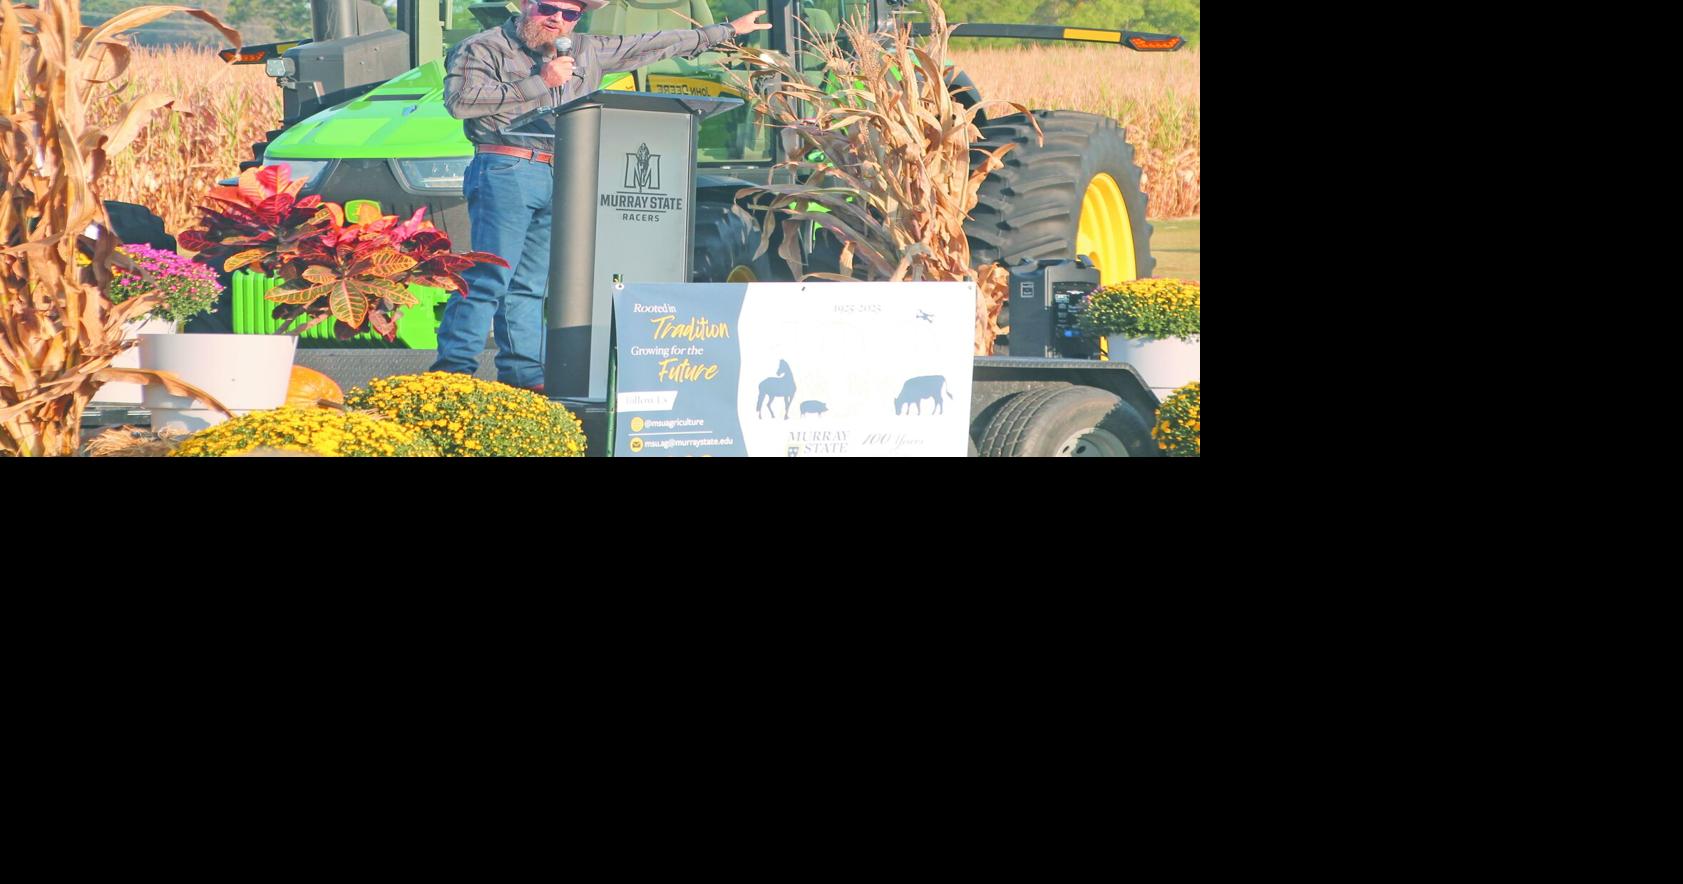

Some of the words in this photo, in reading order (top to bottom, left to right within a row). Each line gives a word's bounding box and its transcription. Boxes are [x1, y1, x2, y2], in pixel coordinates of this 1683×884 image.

[600, 194, 648, 208] MURRAY
[649, 196, 682, 210] STATE
[622, 213, 660, 222] RACERS
[633, 303, 667, 313] Rooted
[667, 304, 677, 313] in
[650, 315, 730, 341] Tradition
[631, 346, 669, 357] Growing
[670, 345, 687, 356] for
[687, 345, 704, 356] the
[658, 358, 719, 383] Future
[644, 418, 704, 429] @msuagriculture
[788, 431, 848, 442] MURRAY
[644, 437, 734, 449] msu.ag@murraystate.edu
[803, 442, 848, 454] STATE
